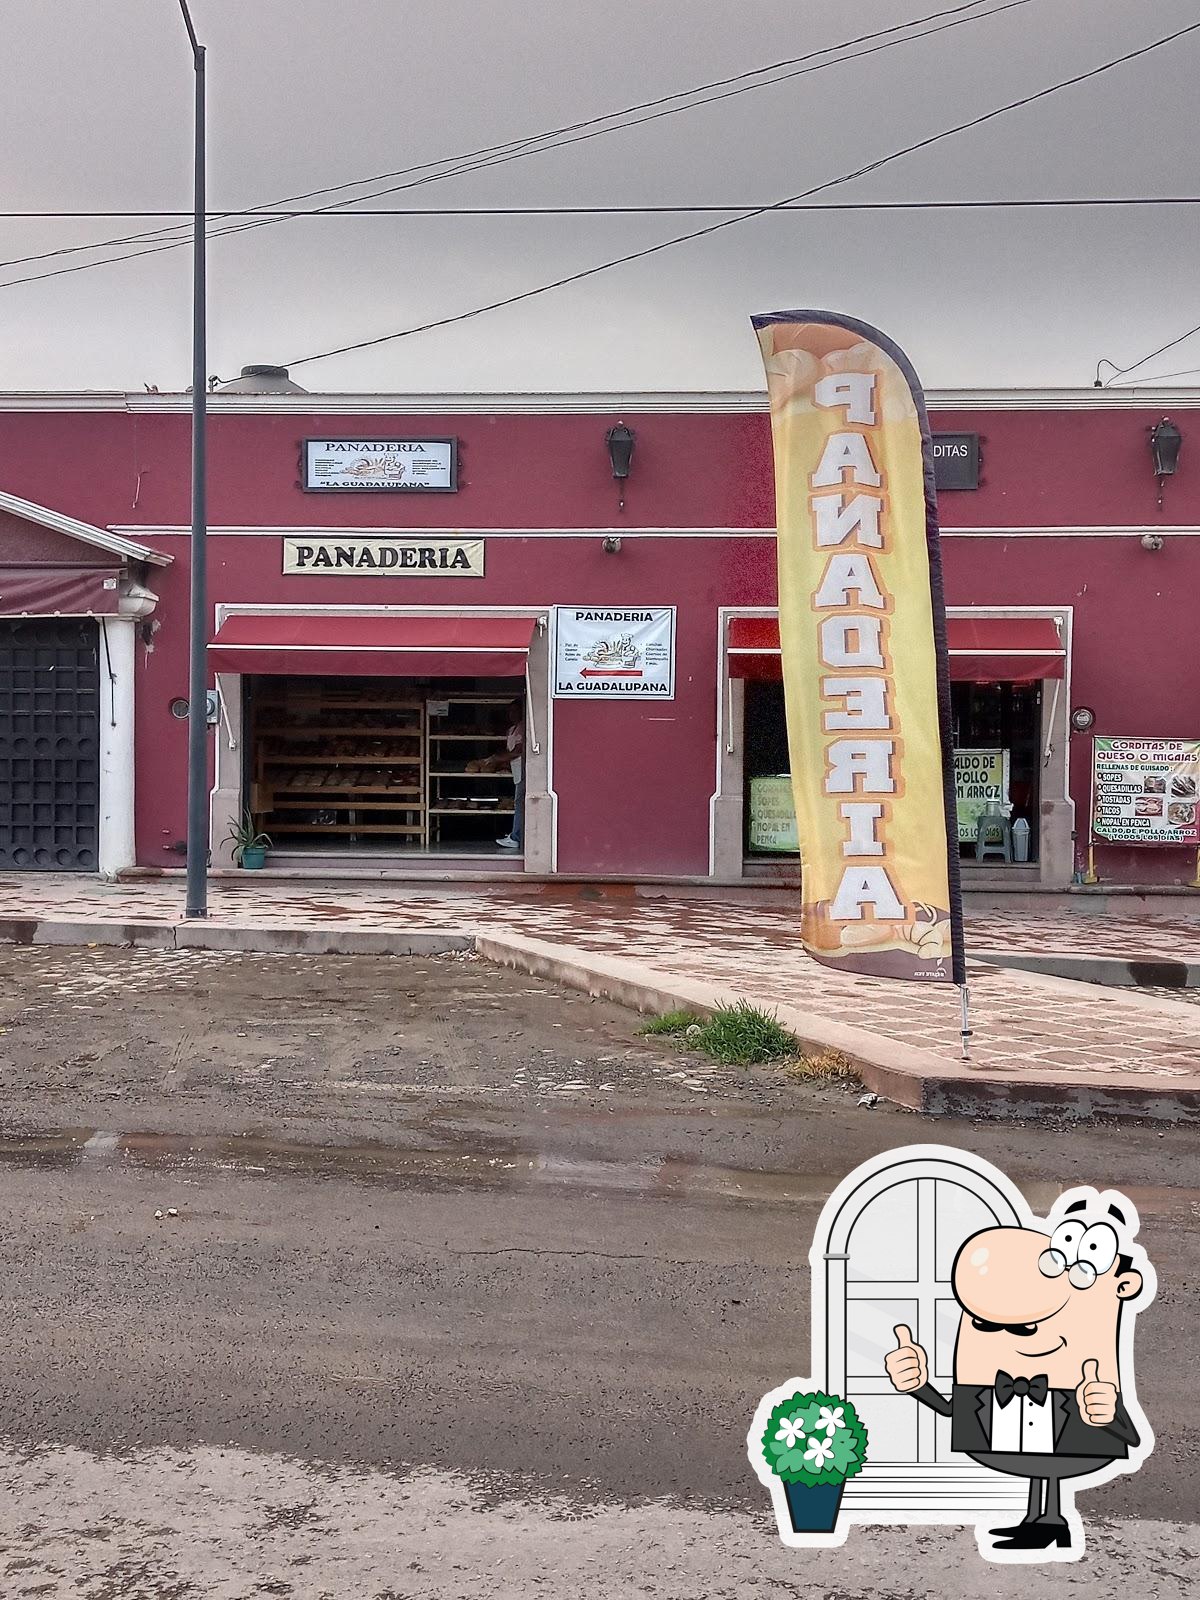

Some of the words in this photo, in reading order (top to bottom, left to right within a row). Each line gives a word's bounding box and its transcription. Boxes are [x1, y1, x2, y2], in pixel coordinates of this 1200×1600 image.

[325, 443, 426, 452] PANADERIA
[933, 445, 968, 457] DITAS
[295, 546, 471, 568] PANADERIA
[575, 612, 653, 621] PANADERIA
[558, 682, 573, 690] LA
[576, 683, 667, 691] GUADALUPANA
[1112, 742, 1165, 750] GORDITAS
[1097, 752, 1135, 760] QUESO
[955, 757, 980, 769] ALDO
[983, 757, 995, 768] DE
[956, 771, 988, 783] POLLO
[1102, 773, 1122, 781] SOPES
[966, 785, 1000, 798] ARROZ
[1102, 785, 1142, 793] QUESADILLAS
[1102, 796, 1131, 804] TOSTADAS
[1102, 806, 1120, 815] TACOS
[1102, 818, 1120, 826] NOPAL
[1121, 818, 1130, 826] EN
[1131, 819, 1150, 827] PENCA
